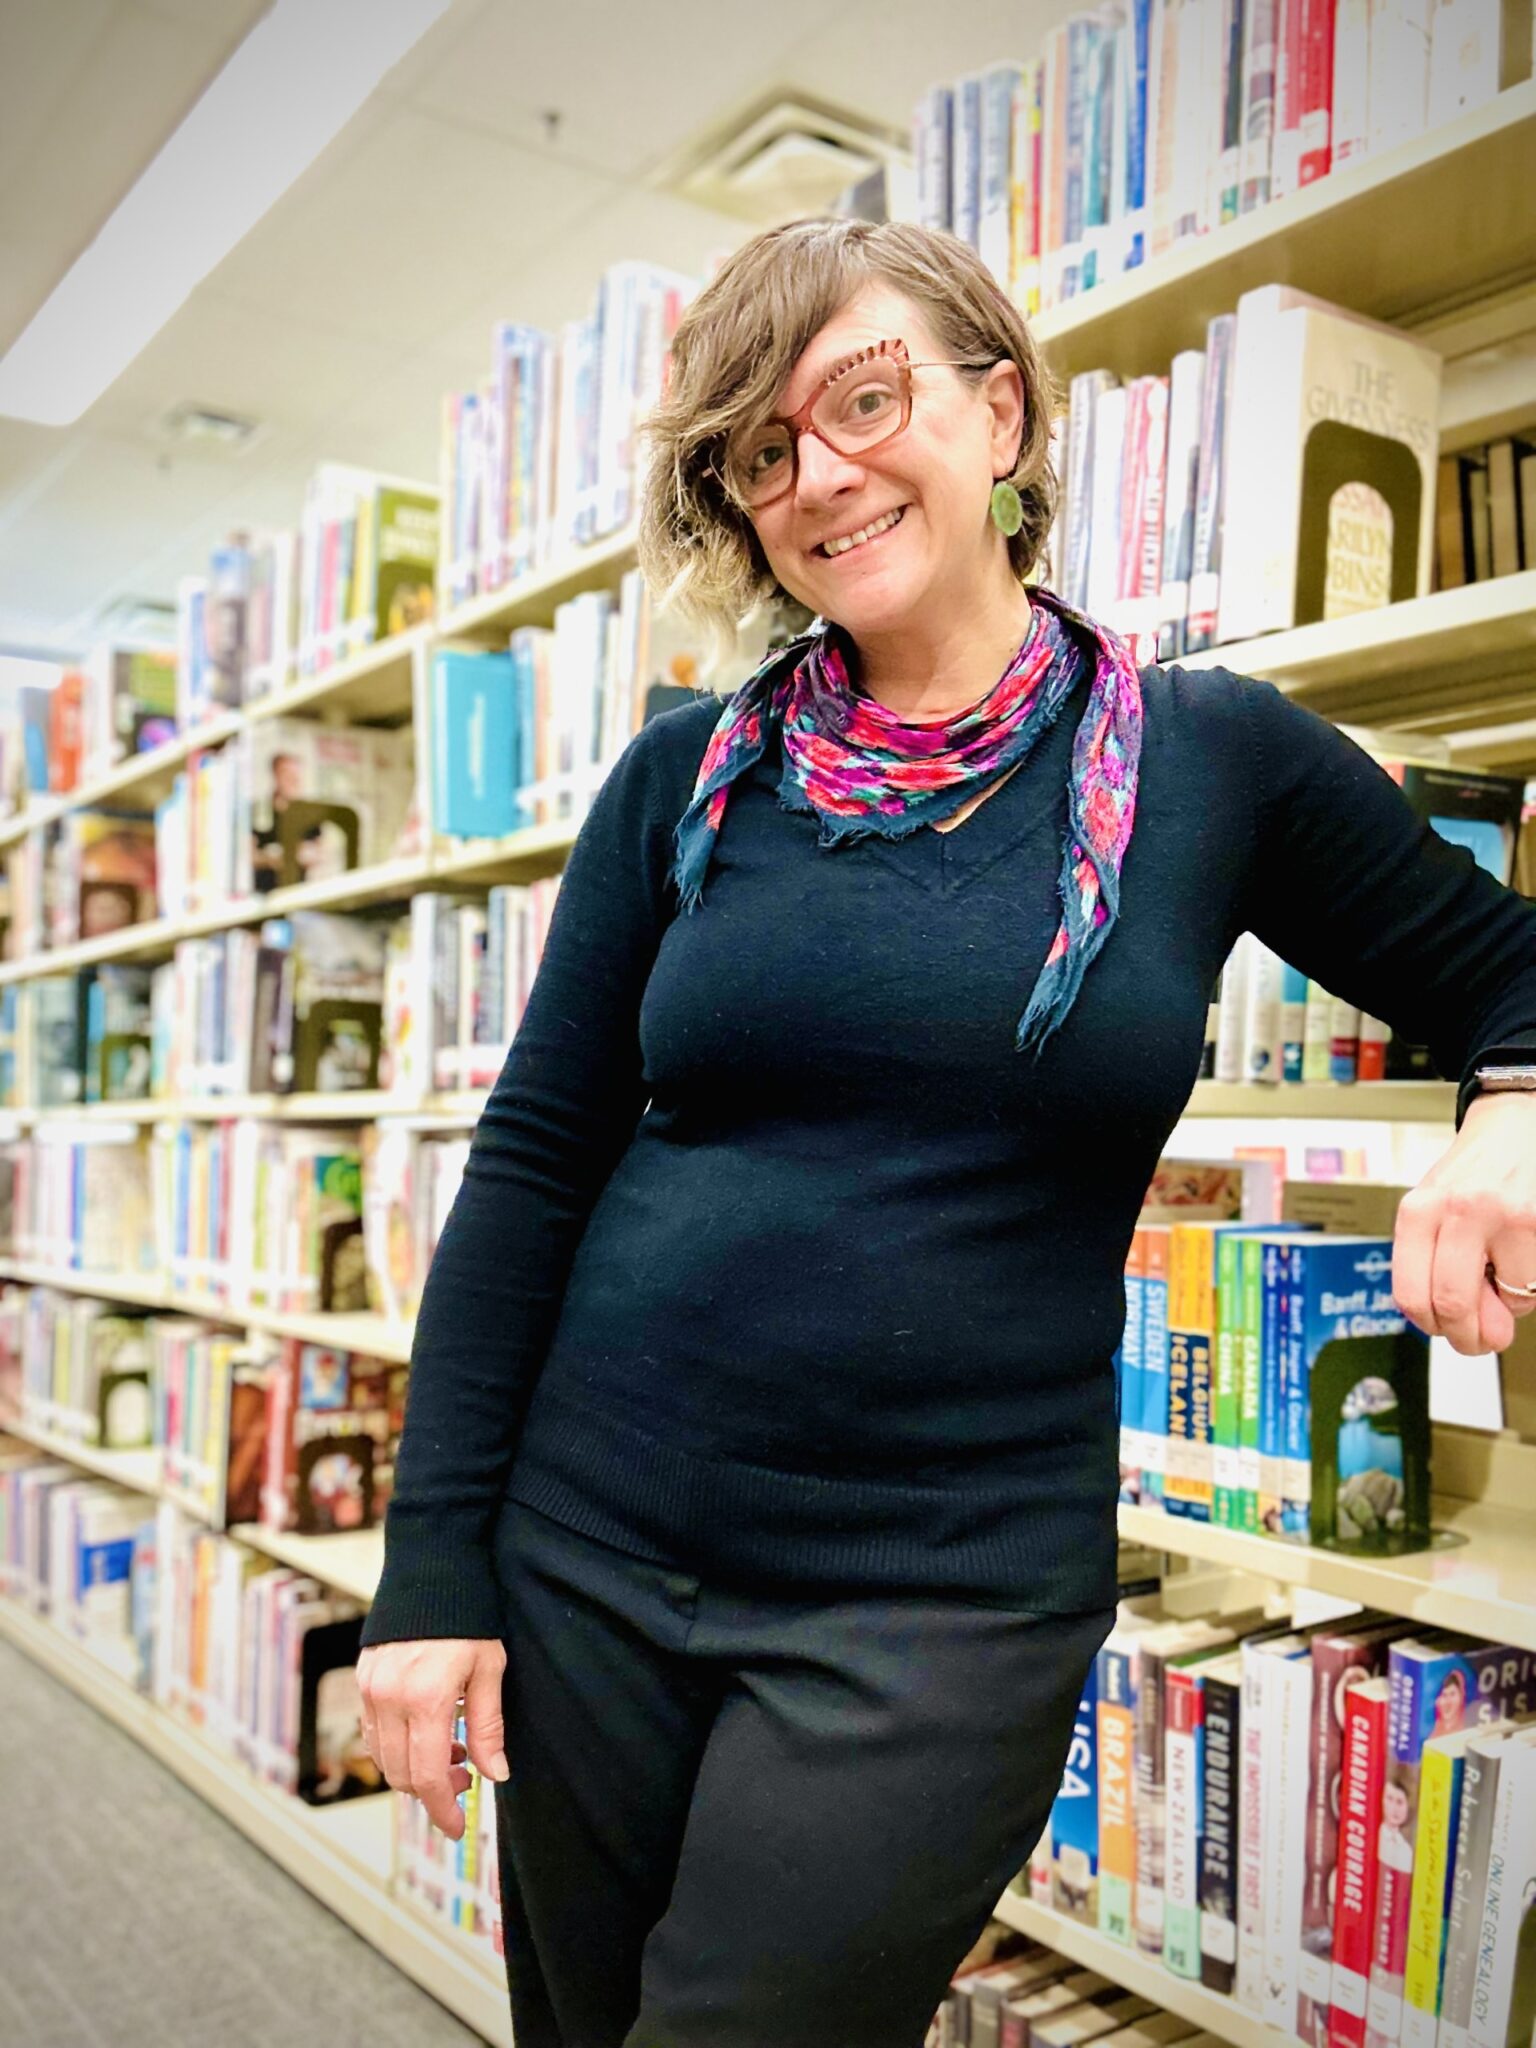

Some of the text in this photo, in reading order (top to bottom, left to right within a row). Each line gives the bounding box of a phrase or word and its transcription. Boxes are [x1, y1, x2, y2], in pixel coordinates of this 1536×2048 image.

[1352, 360, 1394, 403] THE
[1144, 1284, 1167, 1374] SWEDEN
[1218, 1331, 1232, 1396] CHINA
[1242, 1335, 1259, 1420] CANADA
[1398, 1674, 1414, 1750] ORIGINAL
[1478, 1656, 1536, 1694] ORI
[1102, 1716, 1126, 1827] BRAZIL
[1203, 1713, 1230, 1880] ENDURANCE
[1346, 1714, 1370, 1817] CANADIAN
[1172, 1746, 1186, 1899] NEW ZEALAND
[1343, 1819, 1367, 1914] COURAGE
[1451, 1765, 1481, 1930] Rebecca Solnit
[1381, 1872, 1394, 1918] ANITA
[1473, 1853, 1505, 2026] ONLINE GENEALOGY
